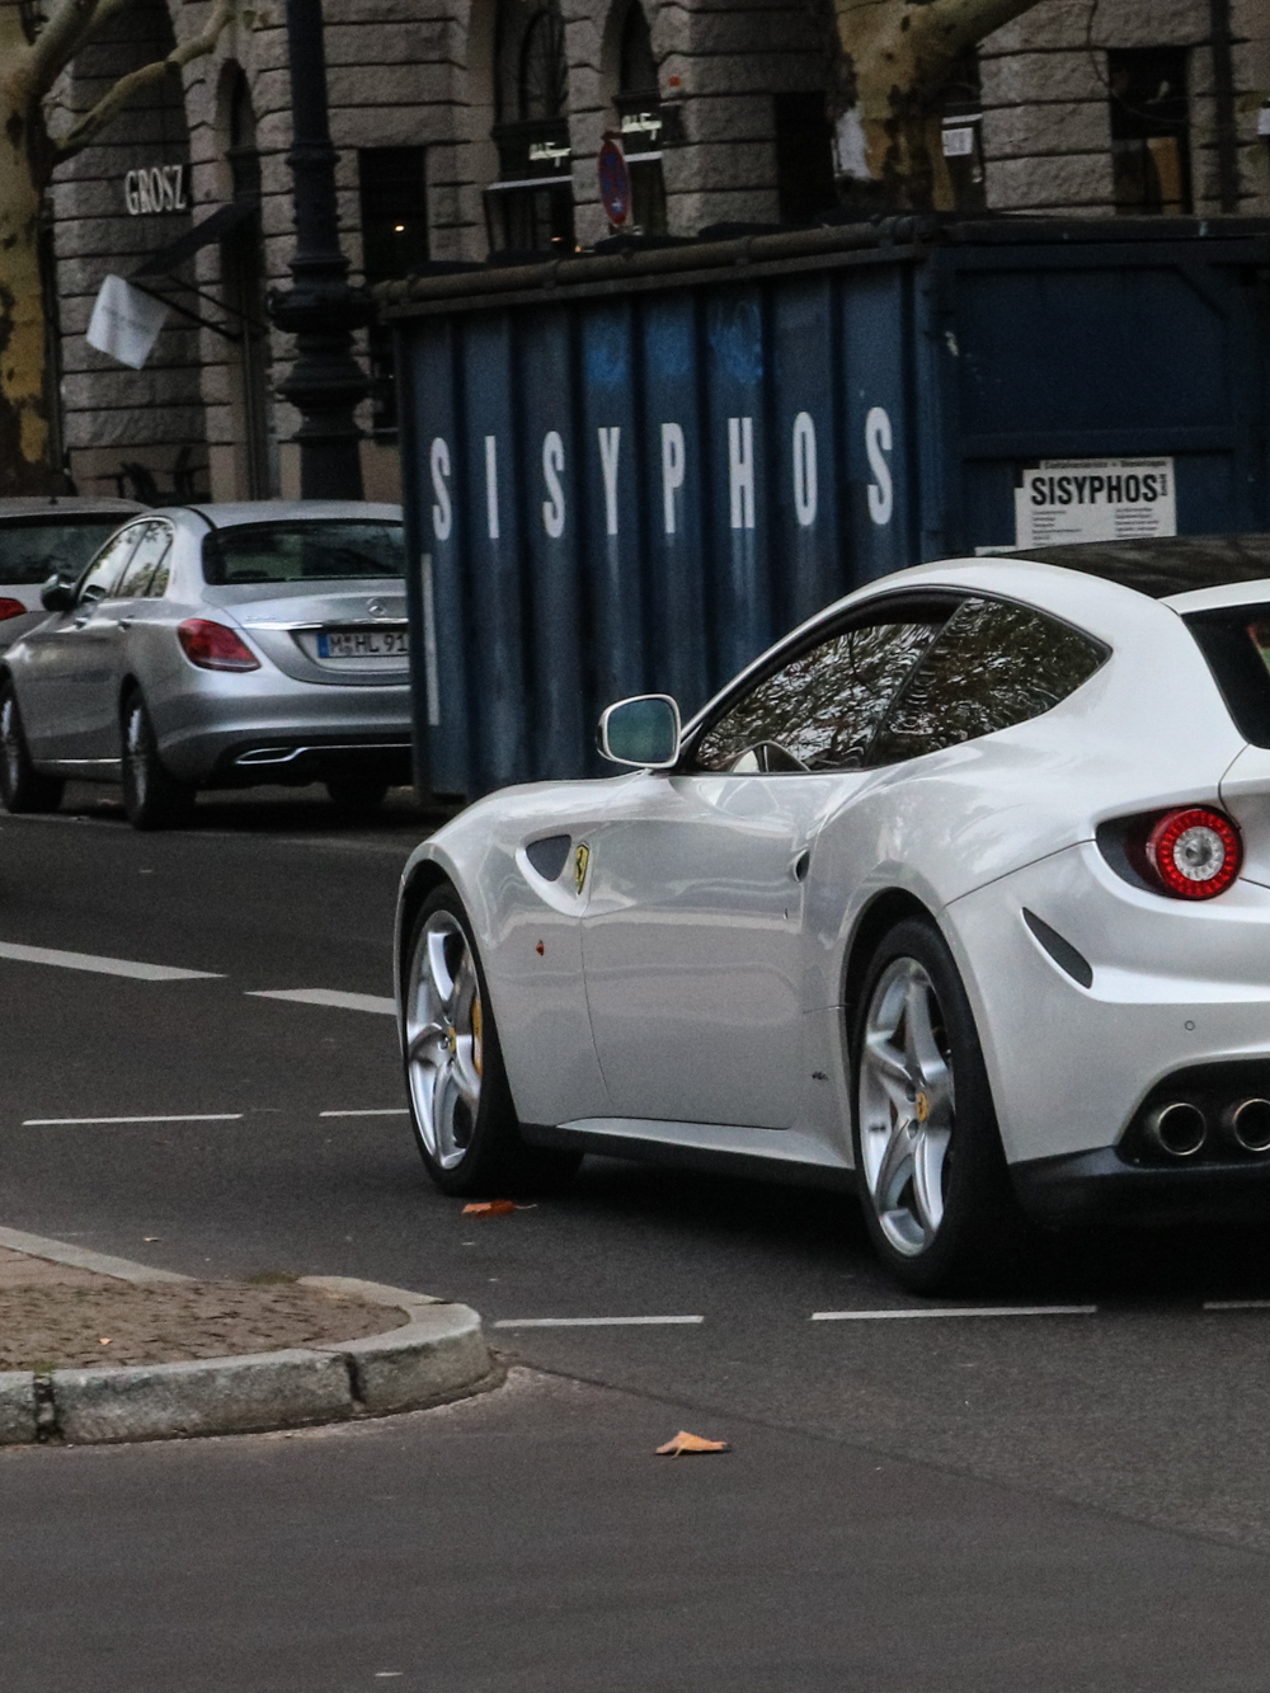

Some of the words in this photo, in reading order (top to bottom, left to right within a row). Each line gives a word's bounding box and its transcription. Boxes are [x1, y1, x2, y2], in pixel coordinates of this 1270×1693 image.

[125, 165, 186, 216] GROSZ
[430, 407, 894, 541] SISYPHOS
[1031, 474, 1158, 505] SISYPHOS
